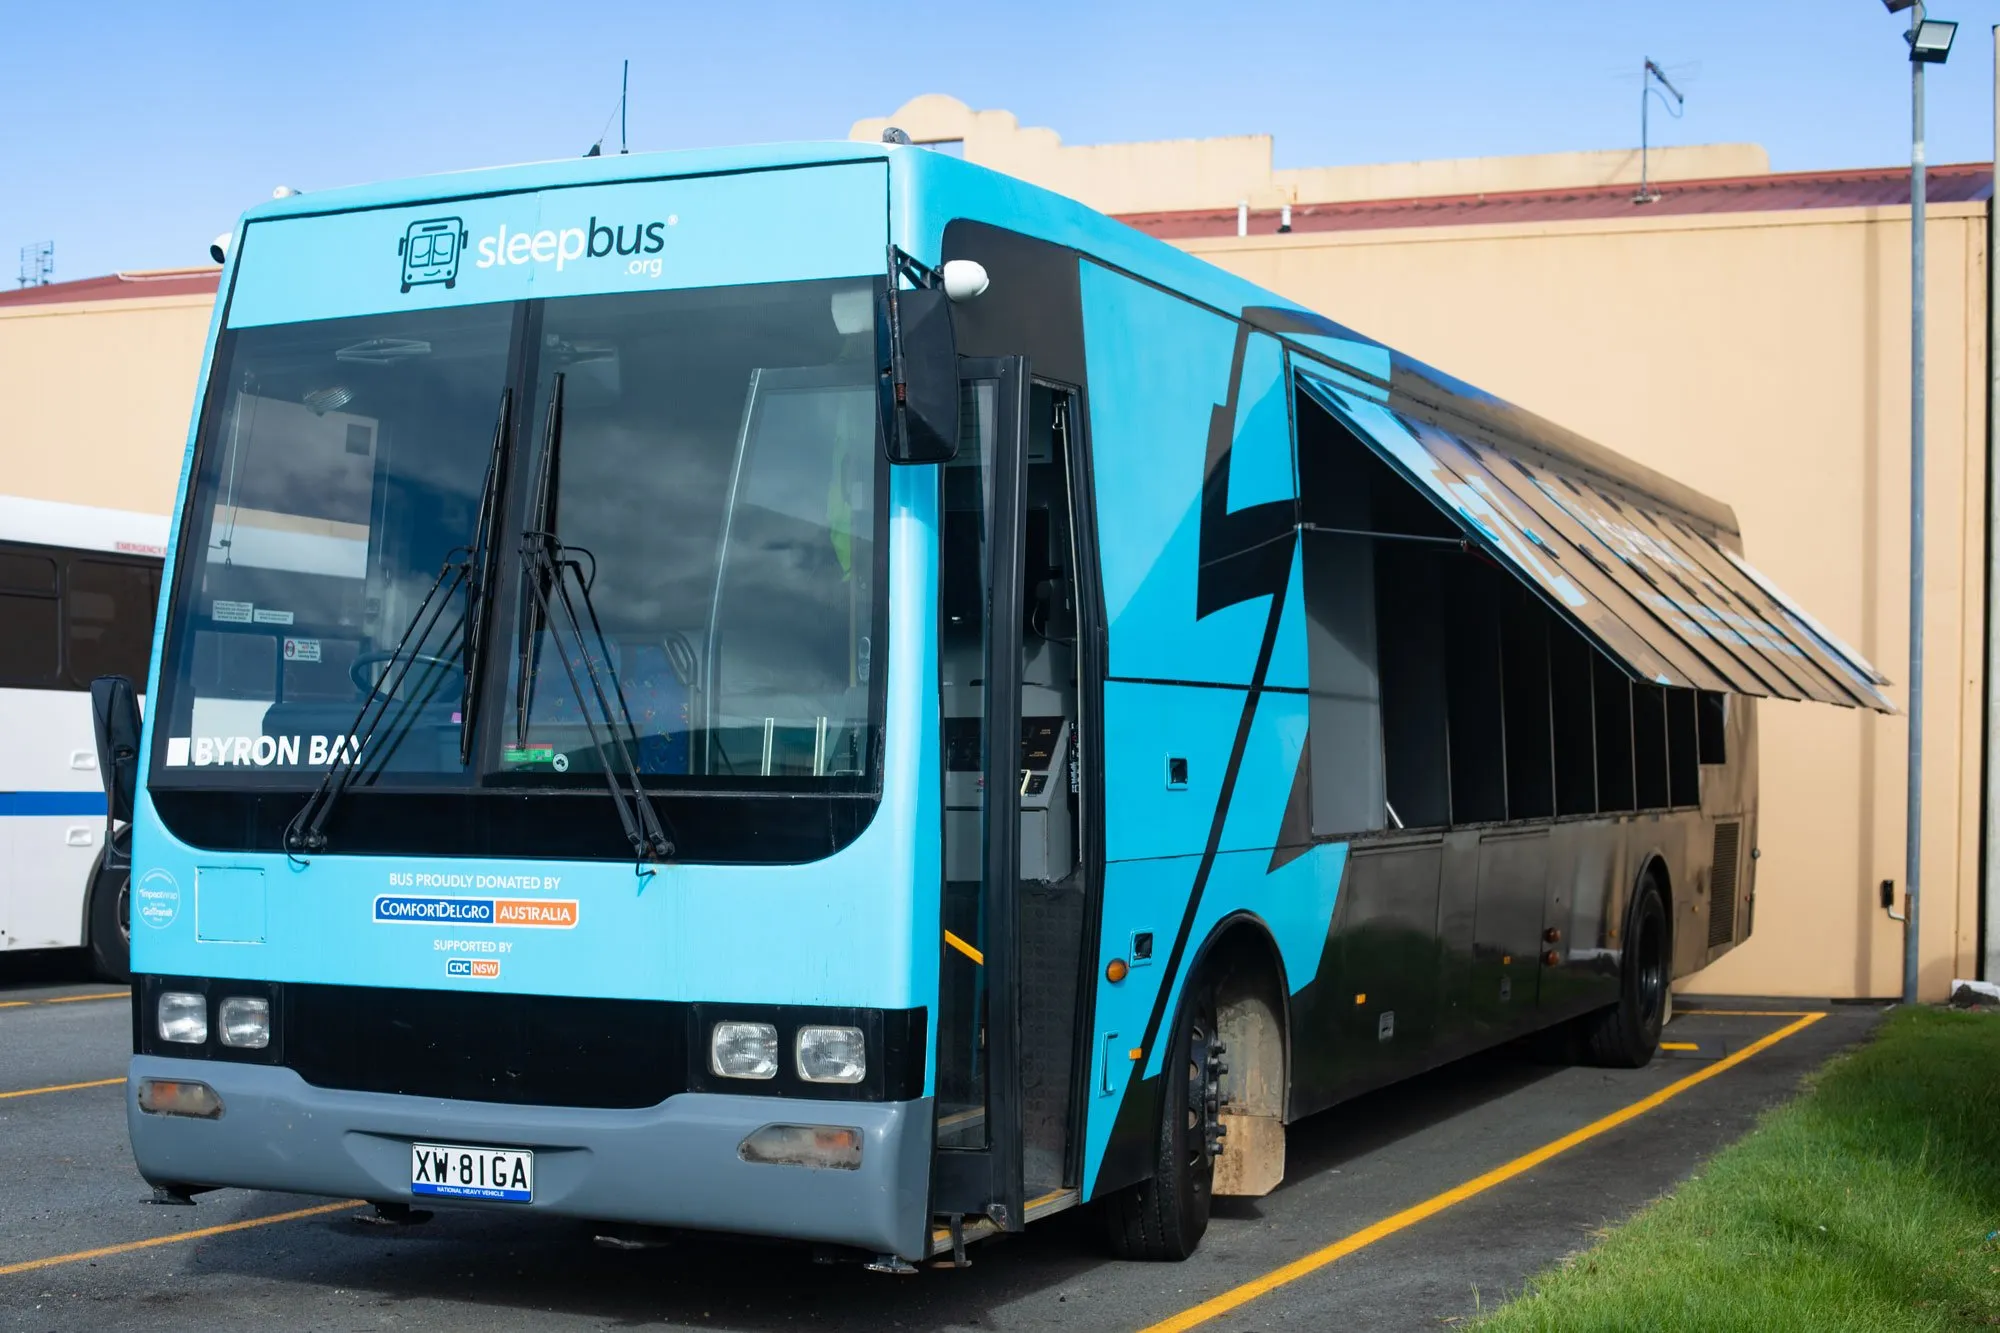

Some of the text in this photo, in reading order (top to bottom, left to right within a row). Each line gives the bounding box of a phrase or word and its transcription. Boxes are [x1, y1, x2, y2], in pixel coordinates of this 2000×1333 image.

[116, 542, 162, 554] EMERGENCY
[195, 735, 372, 766] BYRON BAY
[389, 872, 562, 890] BUS PROUDLY DONATED BY
[499, 905, 571, 922] AUSTRALIA
[433, 939, 513, 953] SUPPORTED BY
[449, 962, 497, 975] CDC NSW
[437, 1186, 505, 1197] NATIONAL HEAVY VEHICLE
